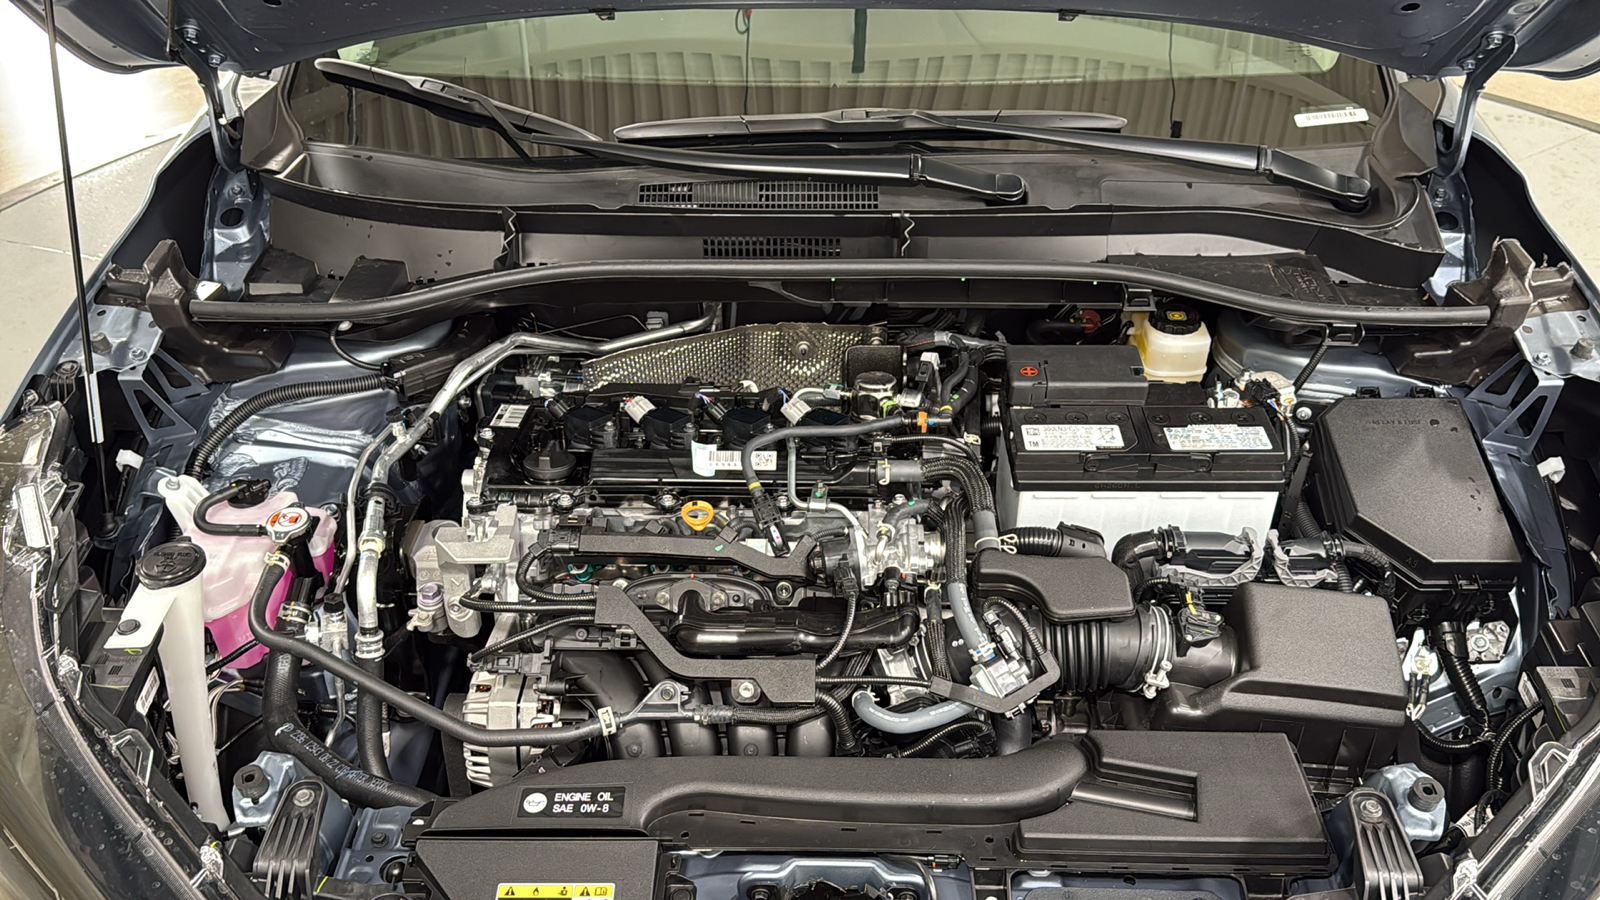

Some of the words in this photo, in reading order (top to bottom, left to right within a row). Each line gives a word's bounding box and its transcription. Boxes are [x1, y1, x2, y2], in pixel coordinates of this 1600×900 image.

[554, 792, 592, 802] ENGINE
[597, 791, 614, 801] OIL
[552, 804, 574, 813] SAE
[580, 804, 609, 813] 0W-8
